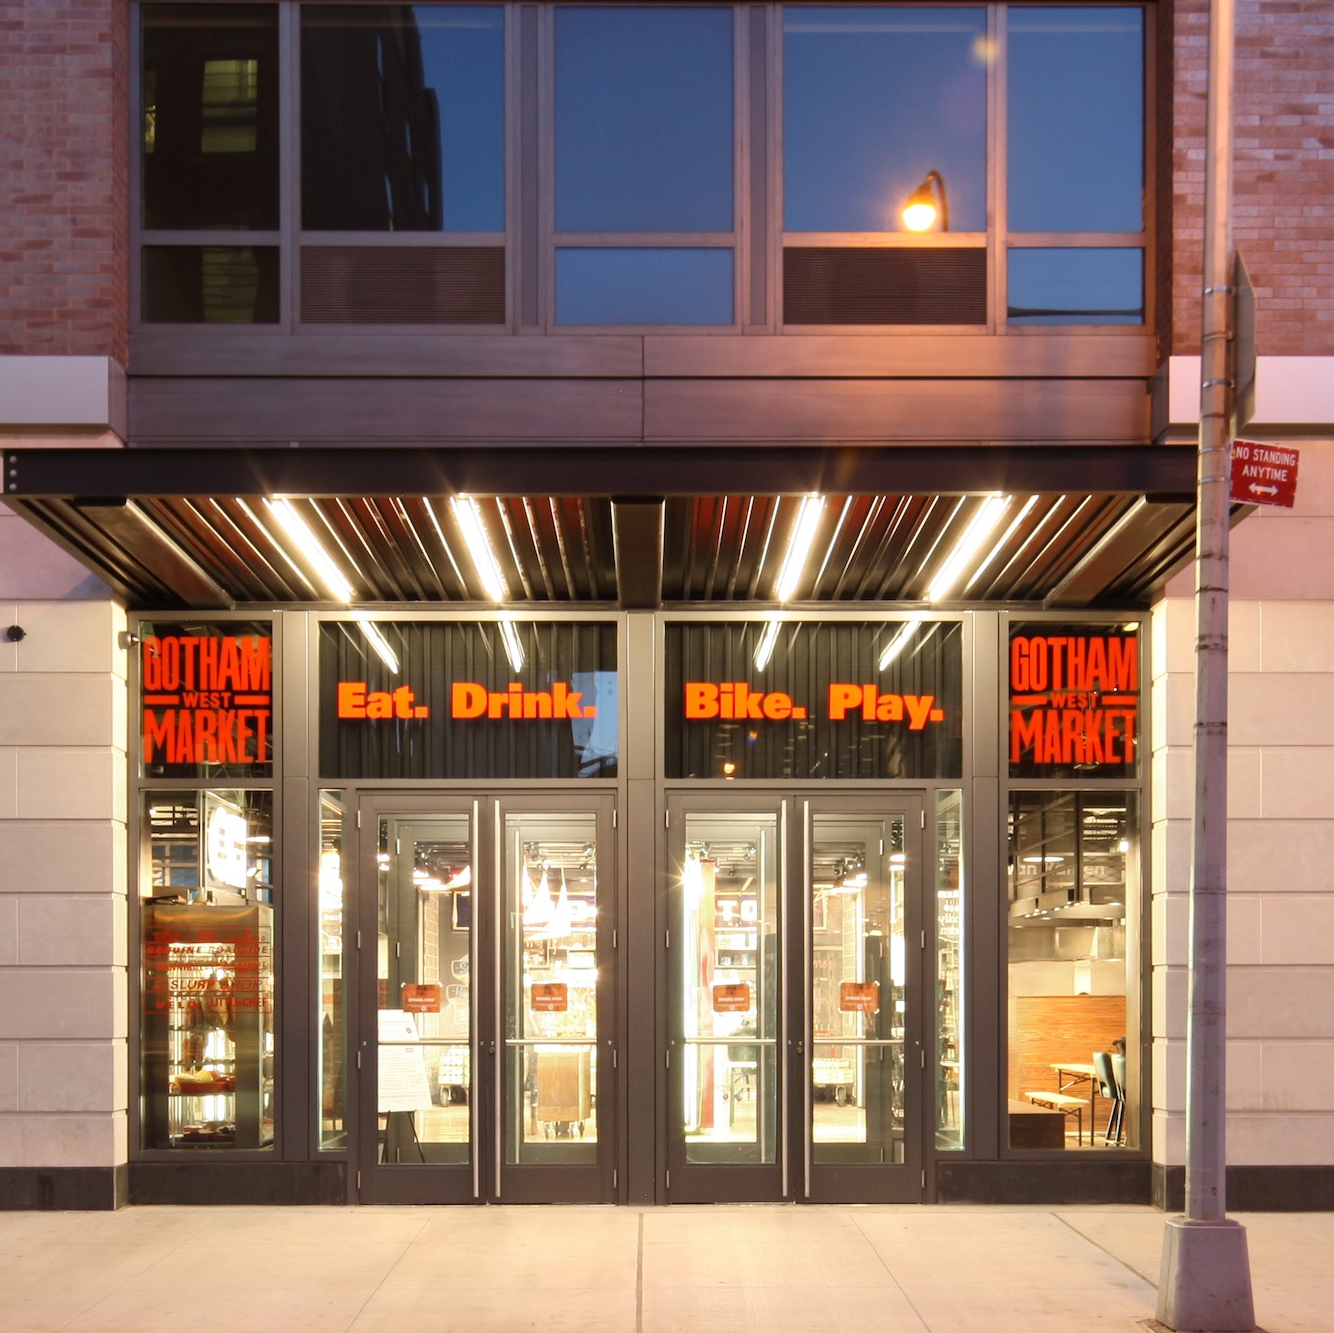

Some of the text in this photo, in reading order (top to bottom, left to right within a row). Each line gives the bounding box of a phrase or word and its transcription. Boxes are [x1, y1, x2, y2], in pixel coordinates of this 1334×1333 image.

[1236, 446, 1296, 466] NO STANDING
[1241, 464, 1288, 482] ANYTIME
[143, 635, 270, 691] GOTHAM
[1011, 635, 1138, 692] GOTHAM
[183, 691, 232, 708] WEST
[338, 682, 598, 719] Eat. Drink.
[685, 682, 944, 730] Bike. Play.
[1050, 691, 1099, 709] WEST
[143, 708, 270, 764] MARKET
[1010, 709, 1138, 764] MARKET
